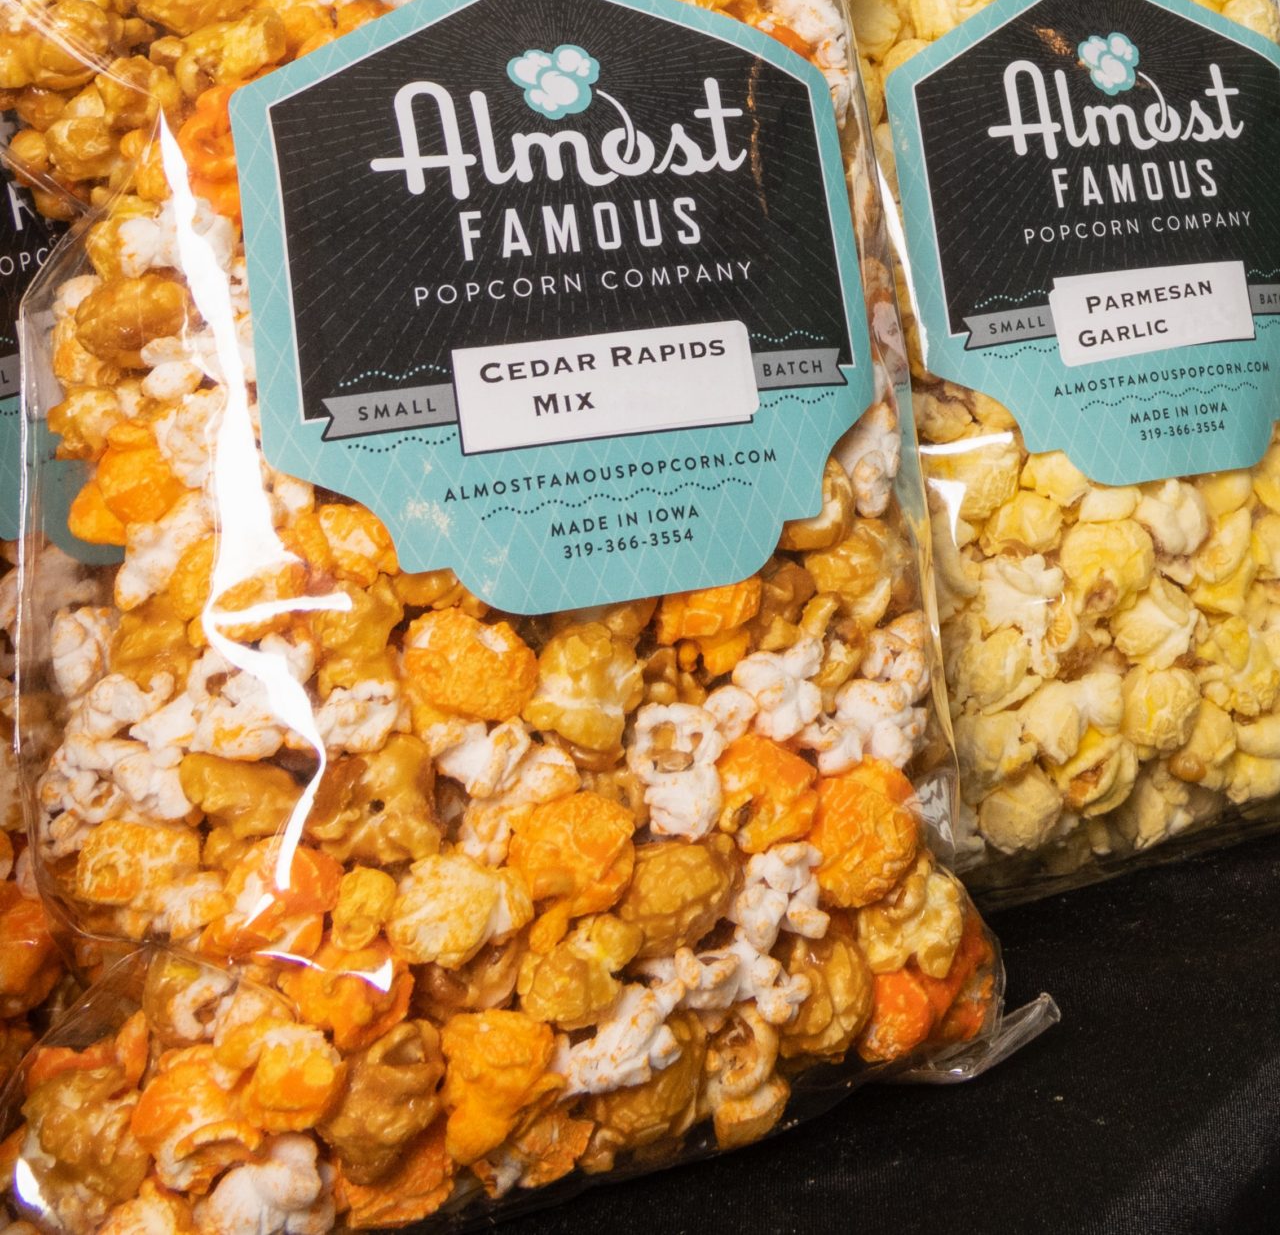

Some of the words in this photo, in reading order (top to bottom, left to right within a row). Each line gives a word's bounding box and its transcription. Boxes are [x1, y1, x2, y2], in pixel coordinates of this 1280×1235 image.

[988, 59, 1244, 160] Almost
[370, 76, 748, 200] Almost
[1052, 158, 1218, 208] FAMOUS
[459, 196, 701, 262] FAMOUS
[1023, 215, 1140, 245] POPCORN
[1151, 210, 1252, 233] COMPANY
[414, 271, 582, 307] POPCORN
[601, 261, 753, 291] COMPANY
[1085, 278, 1213, 315] PARMESAN
[988, 316, 1046, 335] SMALL
[1078, 318, 1169, 348] GARLIC
[479, 352, 598, 385] CEDAR
[610, 338, 726, 370] RAPIDS
[761, 359, 824, 377] BATCH
[1053, 360, 1270, 398] ALMOSTFAMOUSPOPCORN.COM
[356, 397, 438, 422] SMALL
[533, 390, 596, 418] MIX
[1129, 408, 1172, 425] MADE
[1175, 405, 1190, 418] IN
[1194, 401, 1229, 416] IOWA
[1139, 420, 1226, 442] 319-366-3554
[443, 447, 778, 504] ALMOSTFAMOUSPOPCORN.COM
[550, 517, 610, 538] MADE
[617, 513, 638, 529] IN
[646, 504, 700, 524] IOWA
[563, 528, 694, 559] 319-366-3554
